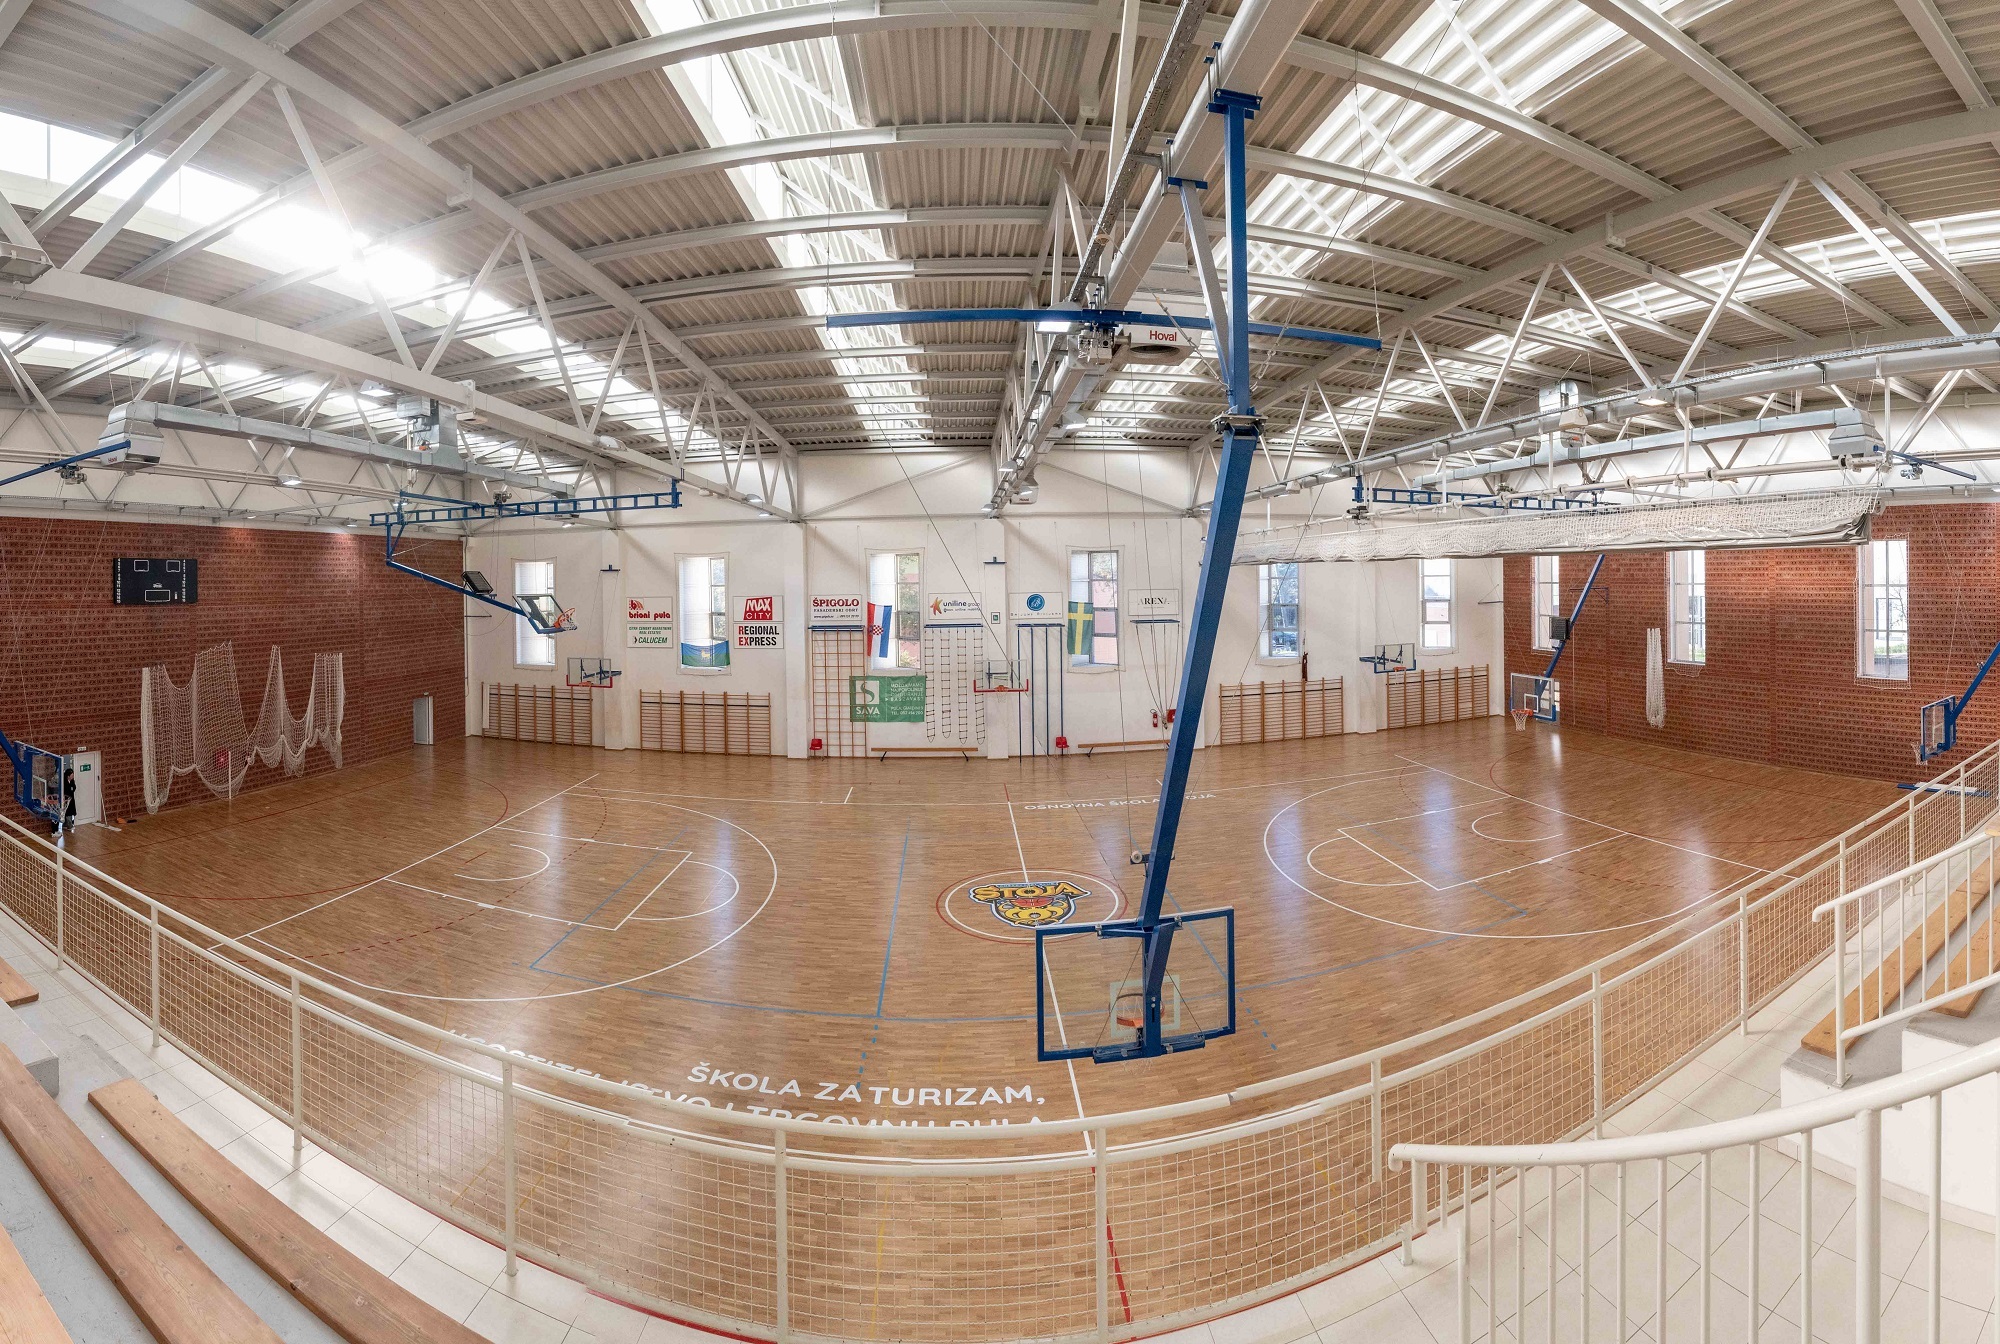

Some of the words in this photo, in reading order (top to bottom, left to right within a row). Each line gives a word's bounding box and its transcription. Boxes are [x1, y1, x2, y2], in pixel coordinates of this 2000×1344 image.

[1149, 330, 1177, 341] Hoval
[746, 598, 771, 611] MAX
[812, 597, 860, 607] ŠPIGOLO
[628, 611, 651, 619] brioni
[653, 611, 671, 621] pula
[745, 612, 772, 620] CITY
[738, 625, 780, 636] REGIONAL
[738, 636, 777, 646] EXPRESS
[855, 706, 881, 715] SAVA
[1024, 802, 1105, 810] OSNOVNA
[1109, 798, 1161, 806] ŠKOLA
[974, 883, 1085, 900] STOJA
[687, 1061, 802, 1098] ŠKOLA
[813, 1082, 862, 1103] ZA
[868, 1085, 1046, 1106] TURIZAM,
